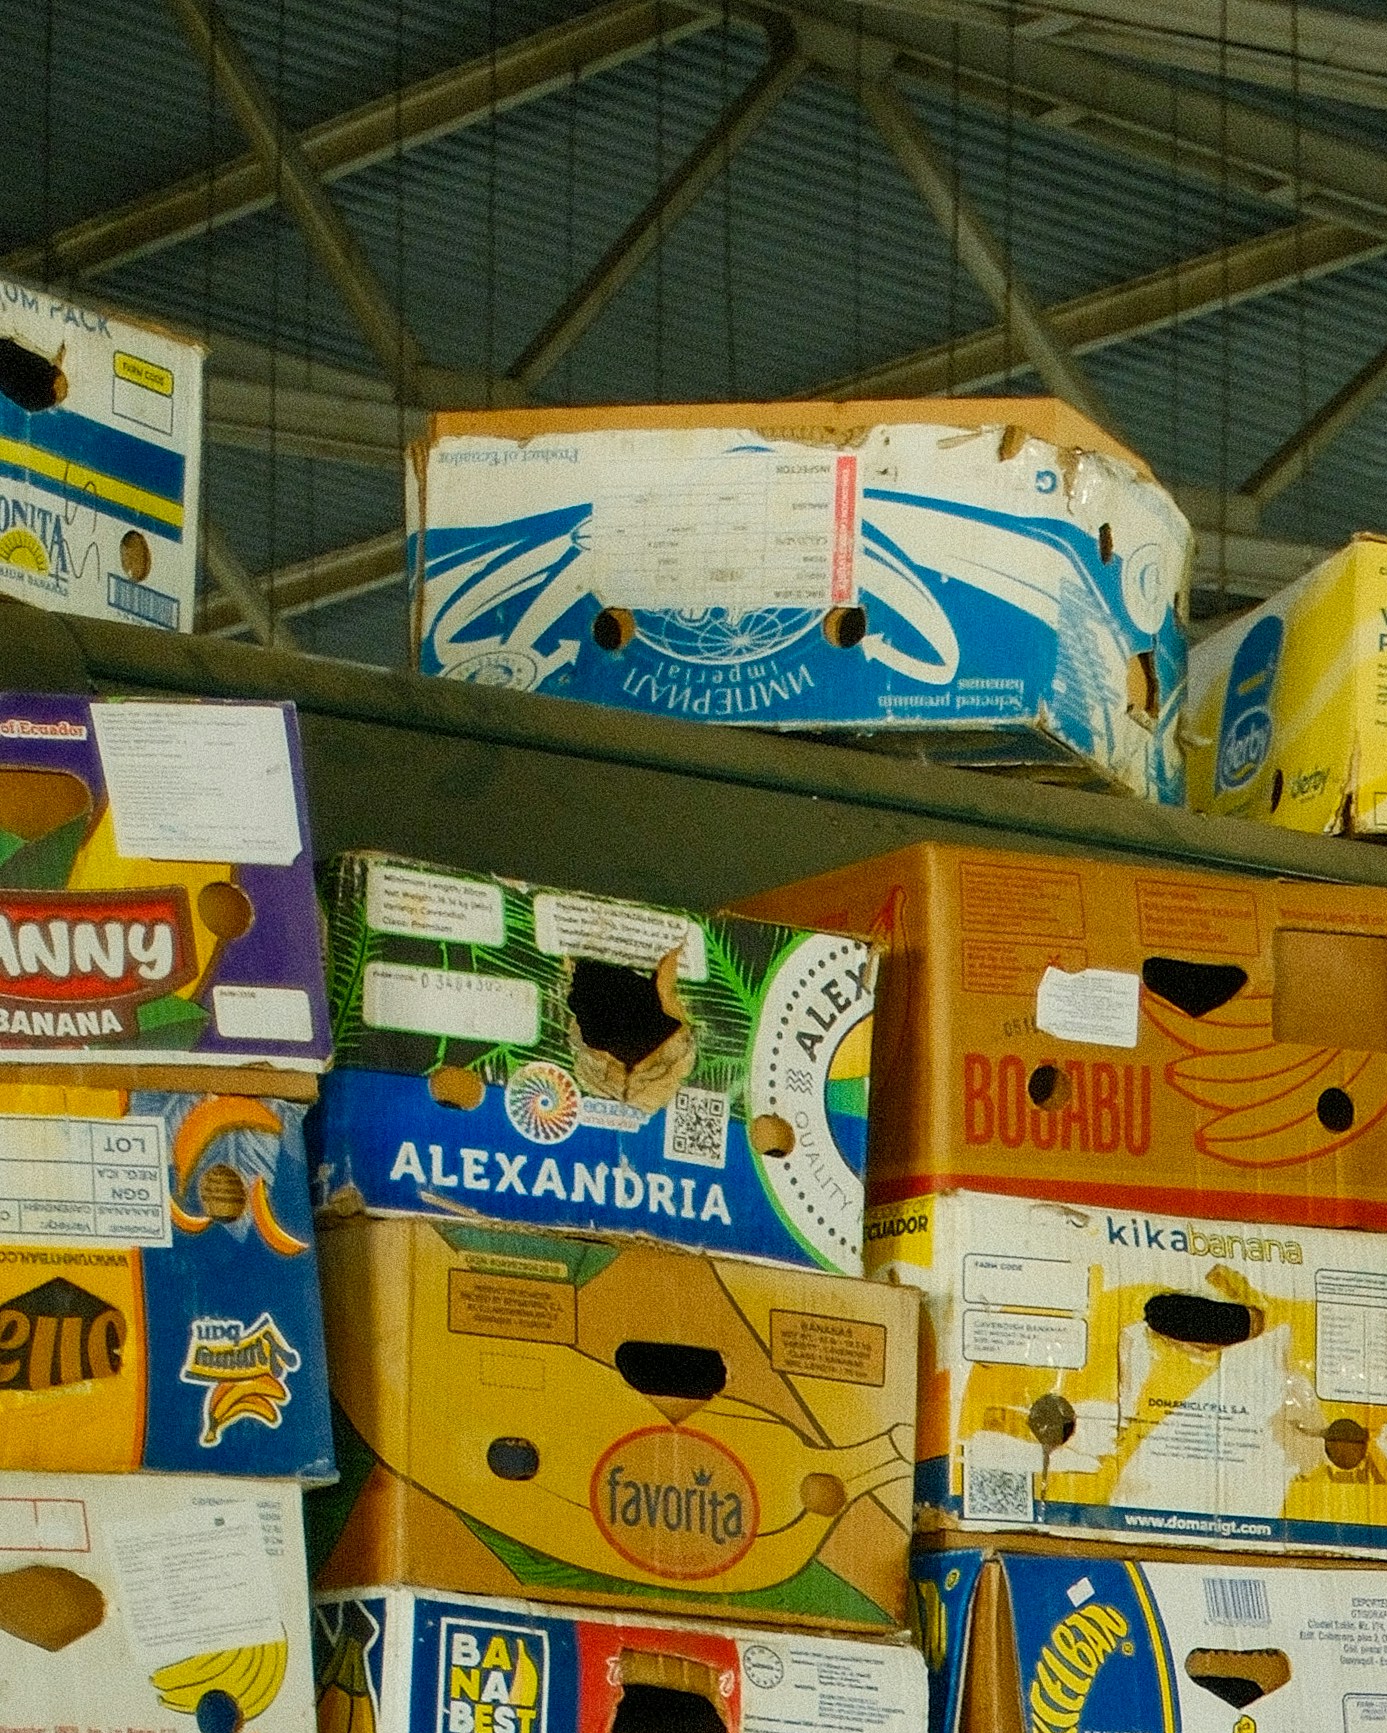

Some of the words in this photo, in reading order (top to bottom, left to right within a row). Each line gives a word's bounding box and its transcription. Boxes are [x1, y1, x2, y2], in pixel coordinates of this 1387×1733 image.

[623, 665, 816, 717] ИМПЕРИАЛ
[958, 679, 1024, 691] bananas
[1, 724, 15, 736] of
[20, 722, 86, 738] Ecuador
[103, 1138, 145, 1153] LOT
[390, 1142, 730, 1224] ALEXANDRIA
[111, 1188, 149, 1200] GGN
[1107, 1217, 1304, 1265] kikabanana
[974, 1259, 999, 1272] FARM
[1002, 1260, 1023, 1273] CODE
[607, 1468, 742, 1544] favorita
